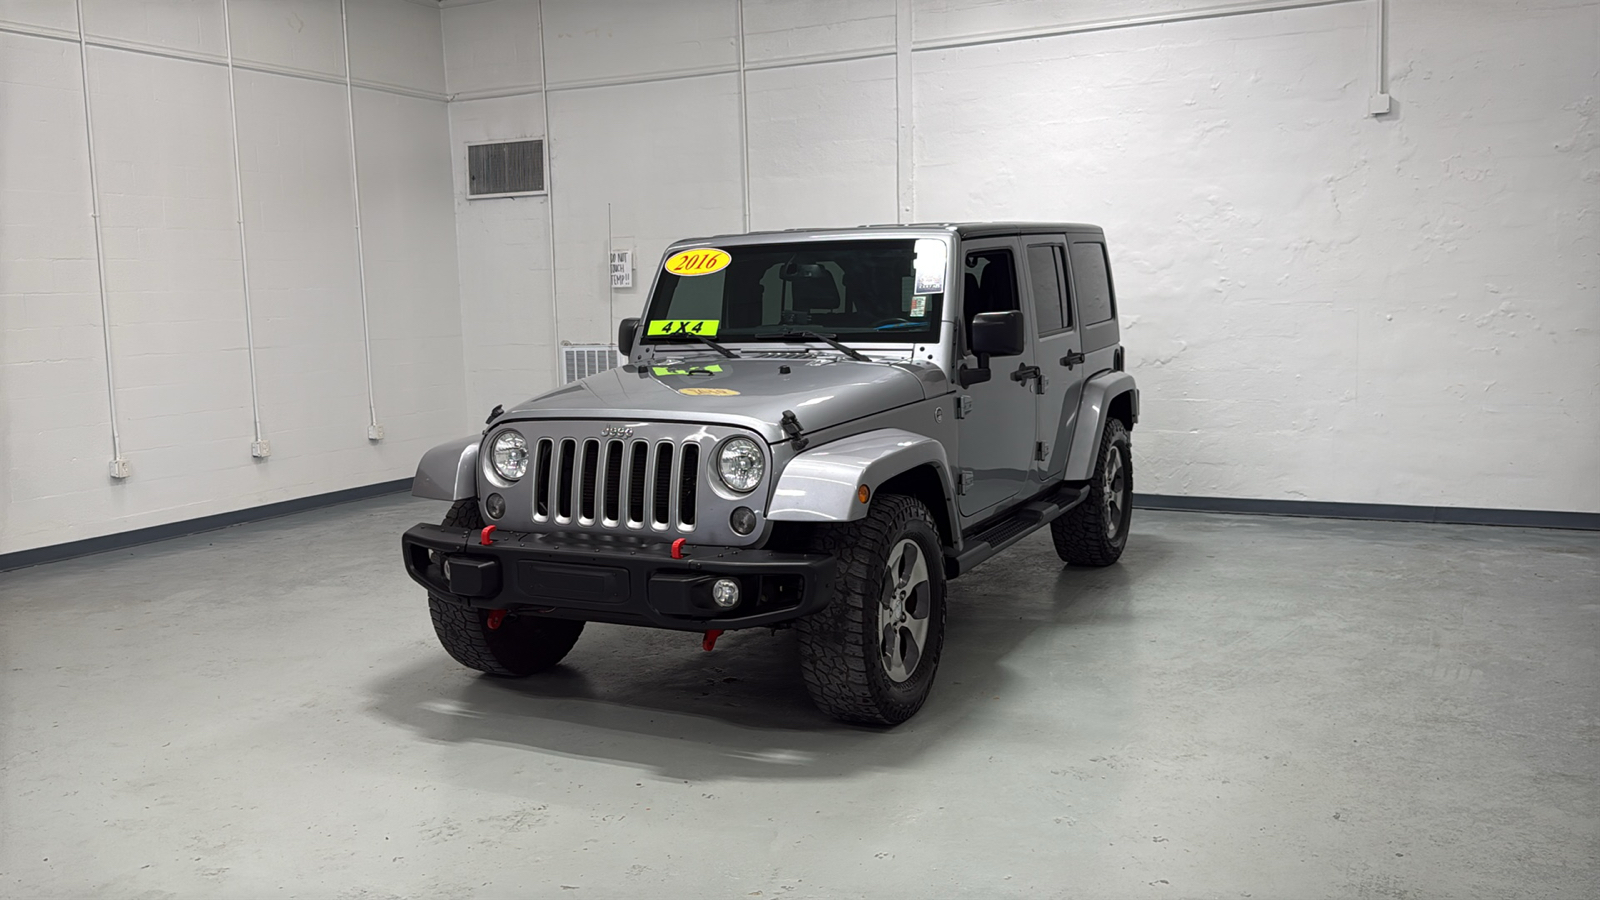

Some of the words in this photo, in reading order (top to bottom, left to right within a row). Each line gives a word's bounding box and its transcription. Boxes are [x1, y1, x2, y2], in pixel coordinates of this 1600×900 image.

[617, 252, 628, 263] NOT
[673, 252, 723, 271] 2016
[600, 425, 634, 440] Jeep
